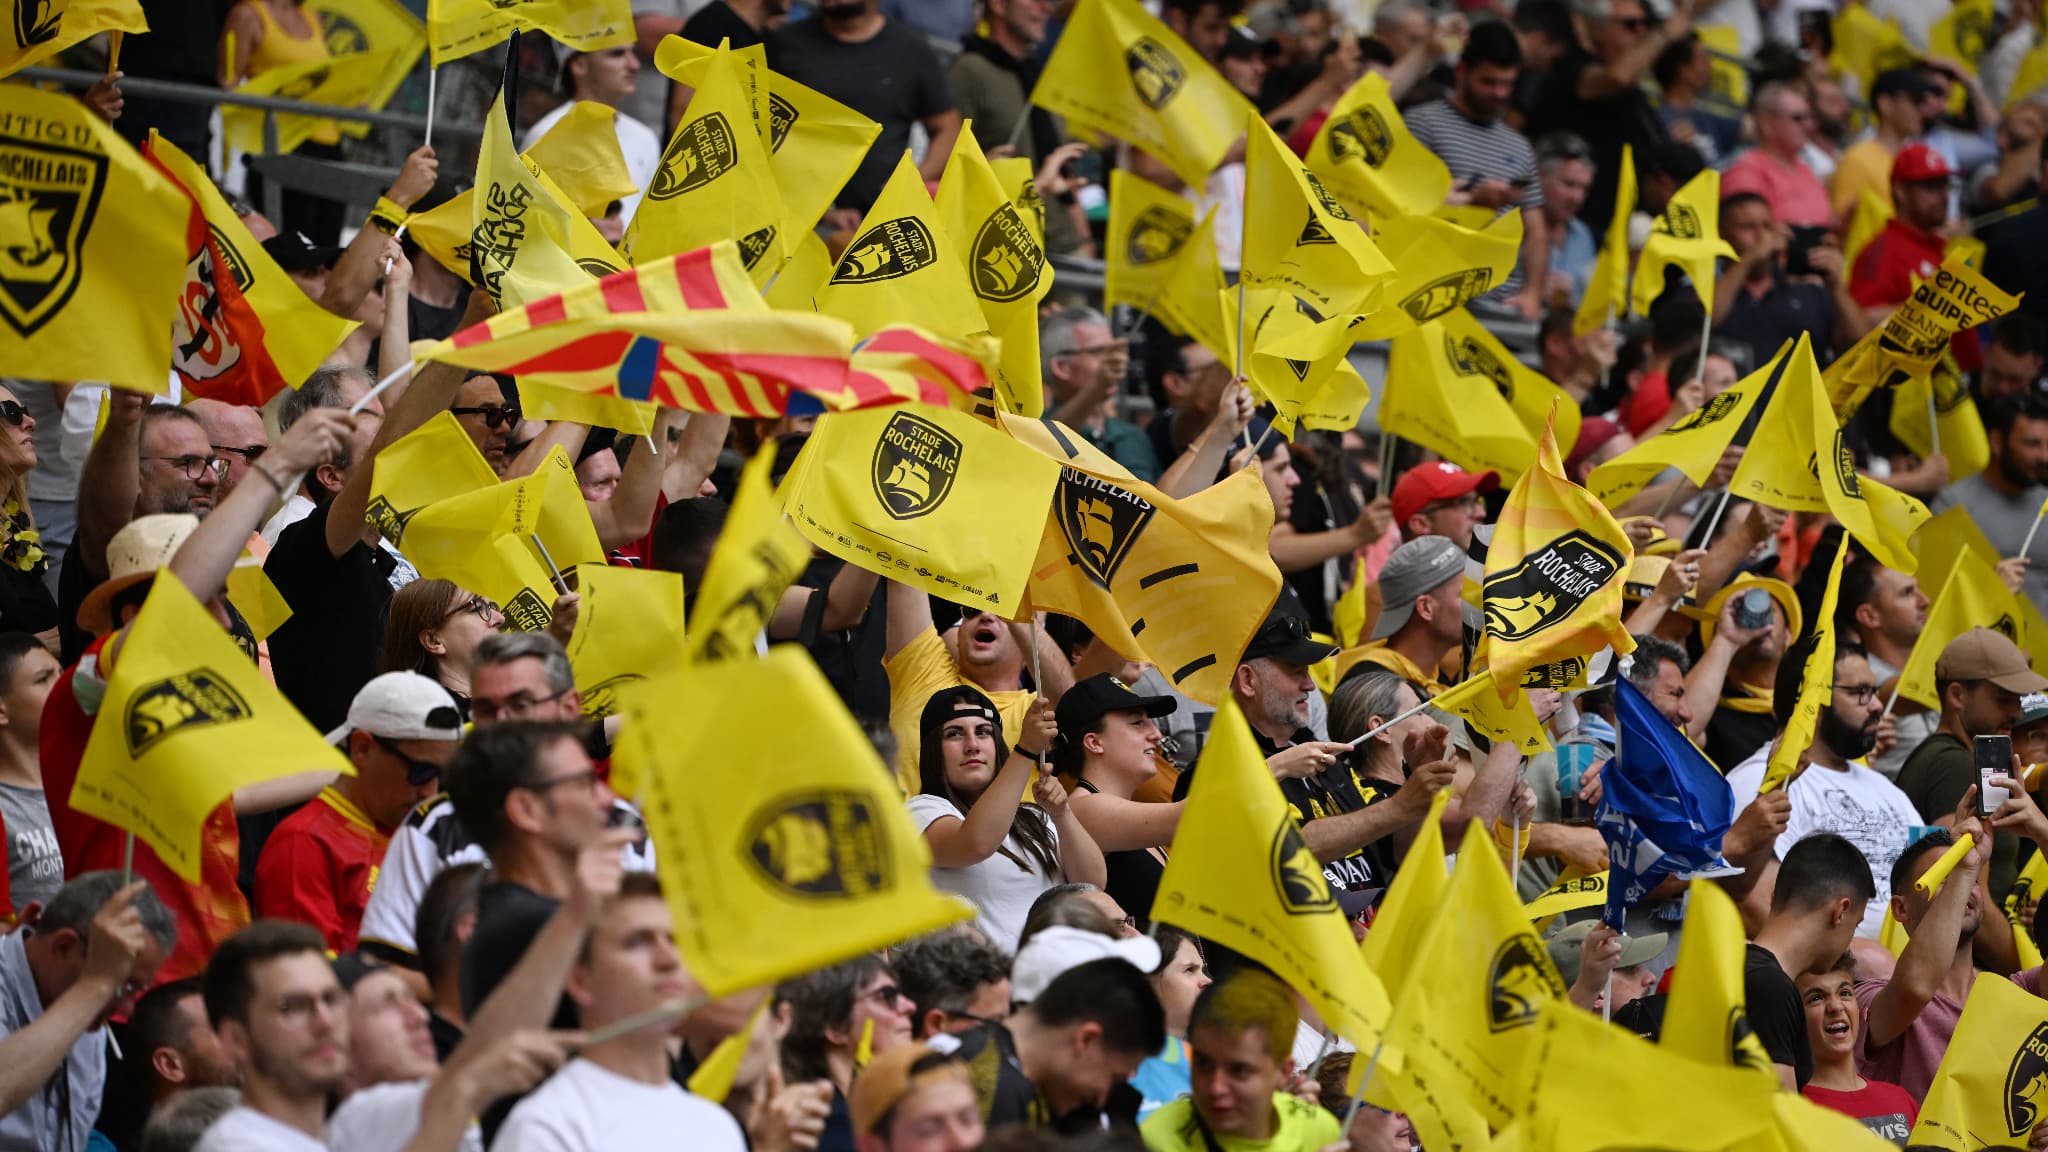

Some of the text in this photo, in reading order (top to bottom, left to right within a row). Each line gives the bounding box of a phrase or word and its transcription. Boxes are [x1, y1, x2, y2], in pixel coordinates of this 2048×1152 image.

[692, 119, 722, 179] ROCHELAIS
[711, 128, 728, 155] STADE
[884, 221, 919, 272] ROCHELAIS
[907, 229, 925, 252] STADE
[993, 211, 1040, 276] ROCHELAIS
[1016, 221, 1036, 250] STADE
[1914, 284, 1973, 330] QUIPE
[884, 426, 956, 474] ROCHELAIS
[910, 425, 942, 449] STADE
[1533, 548, 1600, 599] ROCHELAIS
[1574, 552, 1606, 575] STADE
